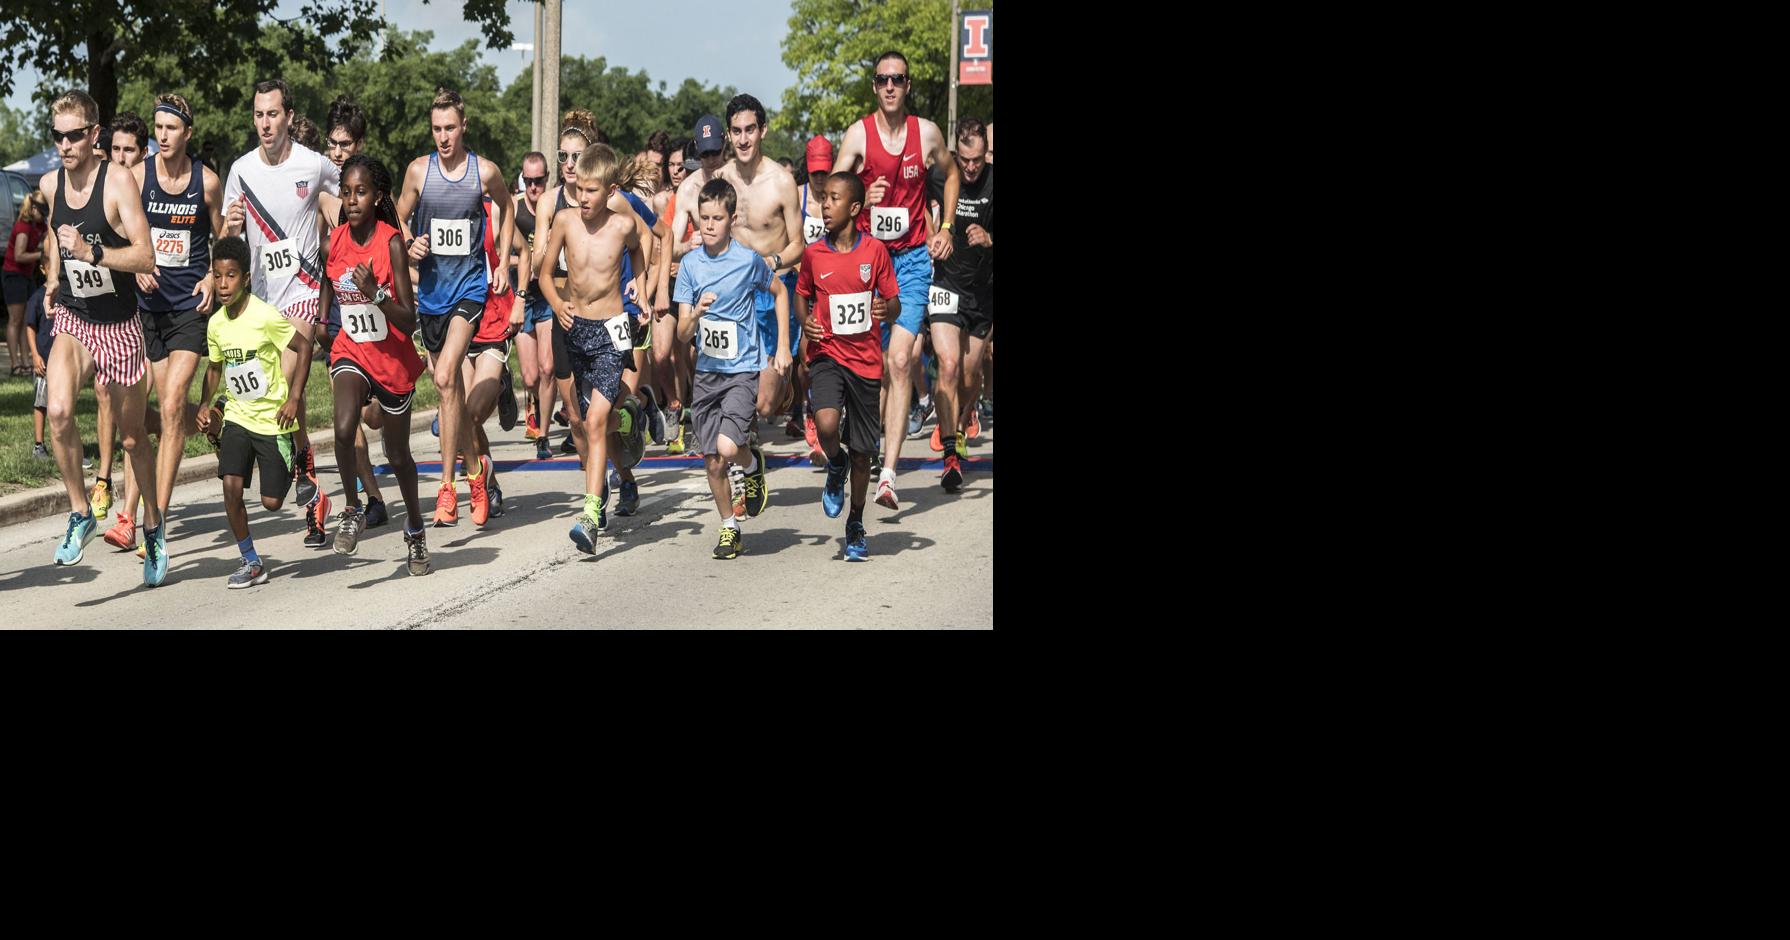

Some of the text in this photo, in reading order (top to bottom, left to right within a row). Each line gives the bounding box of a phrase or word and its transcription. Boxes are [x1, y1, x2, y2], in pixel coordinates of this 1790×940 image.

[903, 165, 919, 179] USA
[147, 202, 198, 216] ILLINOIS
[171, 215, 197, 224] ELITE
[876, 215, 902, 232] 296
[156, 239, 184, 254] 2275
[437, 227, 463, 247] 306
[265, 248, 292, 271] 305
[72, 269, 104, 289] 349
[931, 291, 951, 306] 468
[348, 313, 378, 334] 311
[837, 302, 865, 325] 325
[704, 327, 729, 349] 265
[230, 371, 259, 395] 316
